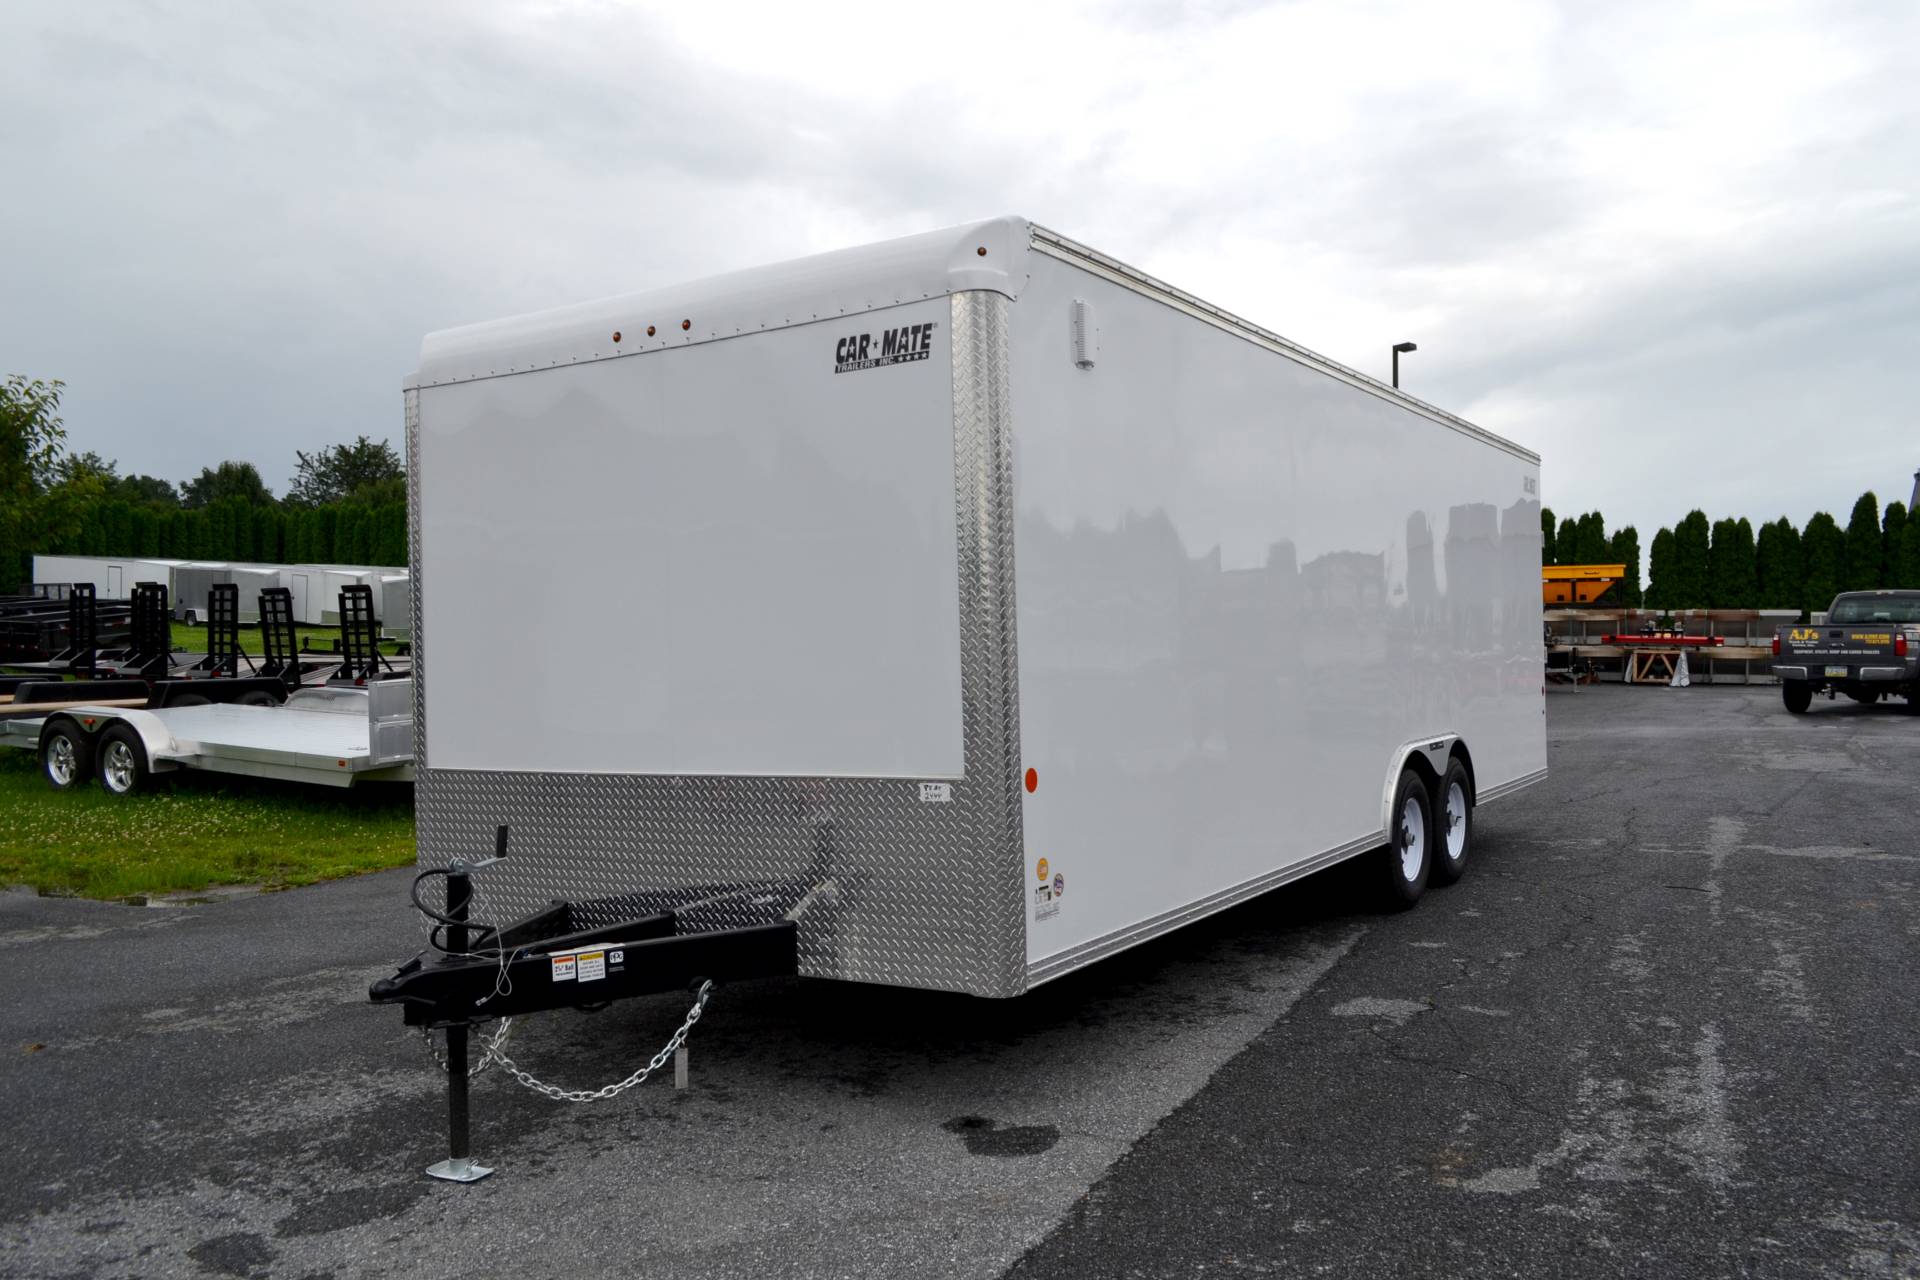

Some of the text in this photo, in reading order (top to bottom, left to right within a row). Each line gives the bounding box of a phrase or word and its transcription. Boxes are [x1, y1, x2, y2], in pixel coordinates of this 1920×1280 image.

[836, 322, 933, 364] CAR MATE
[836, 357, 896, 373] TRAILERS INC.
